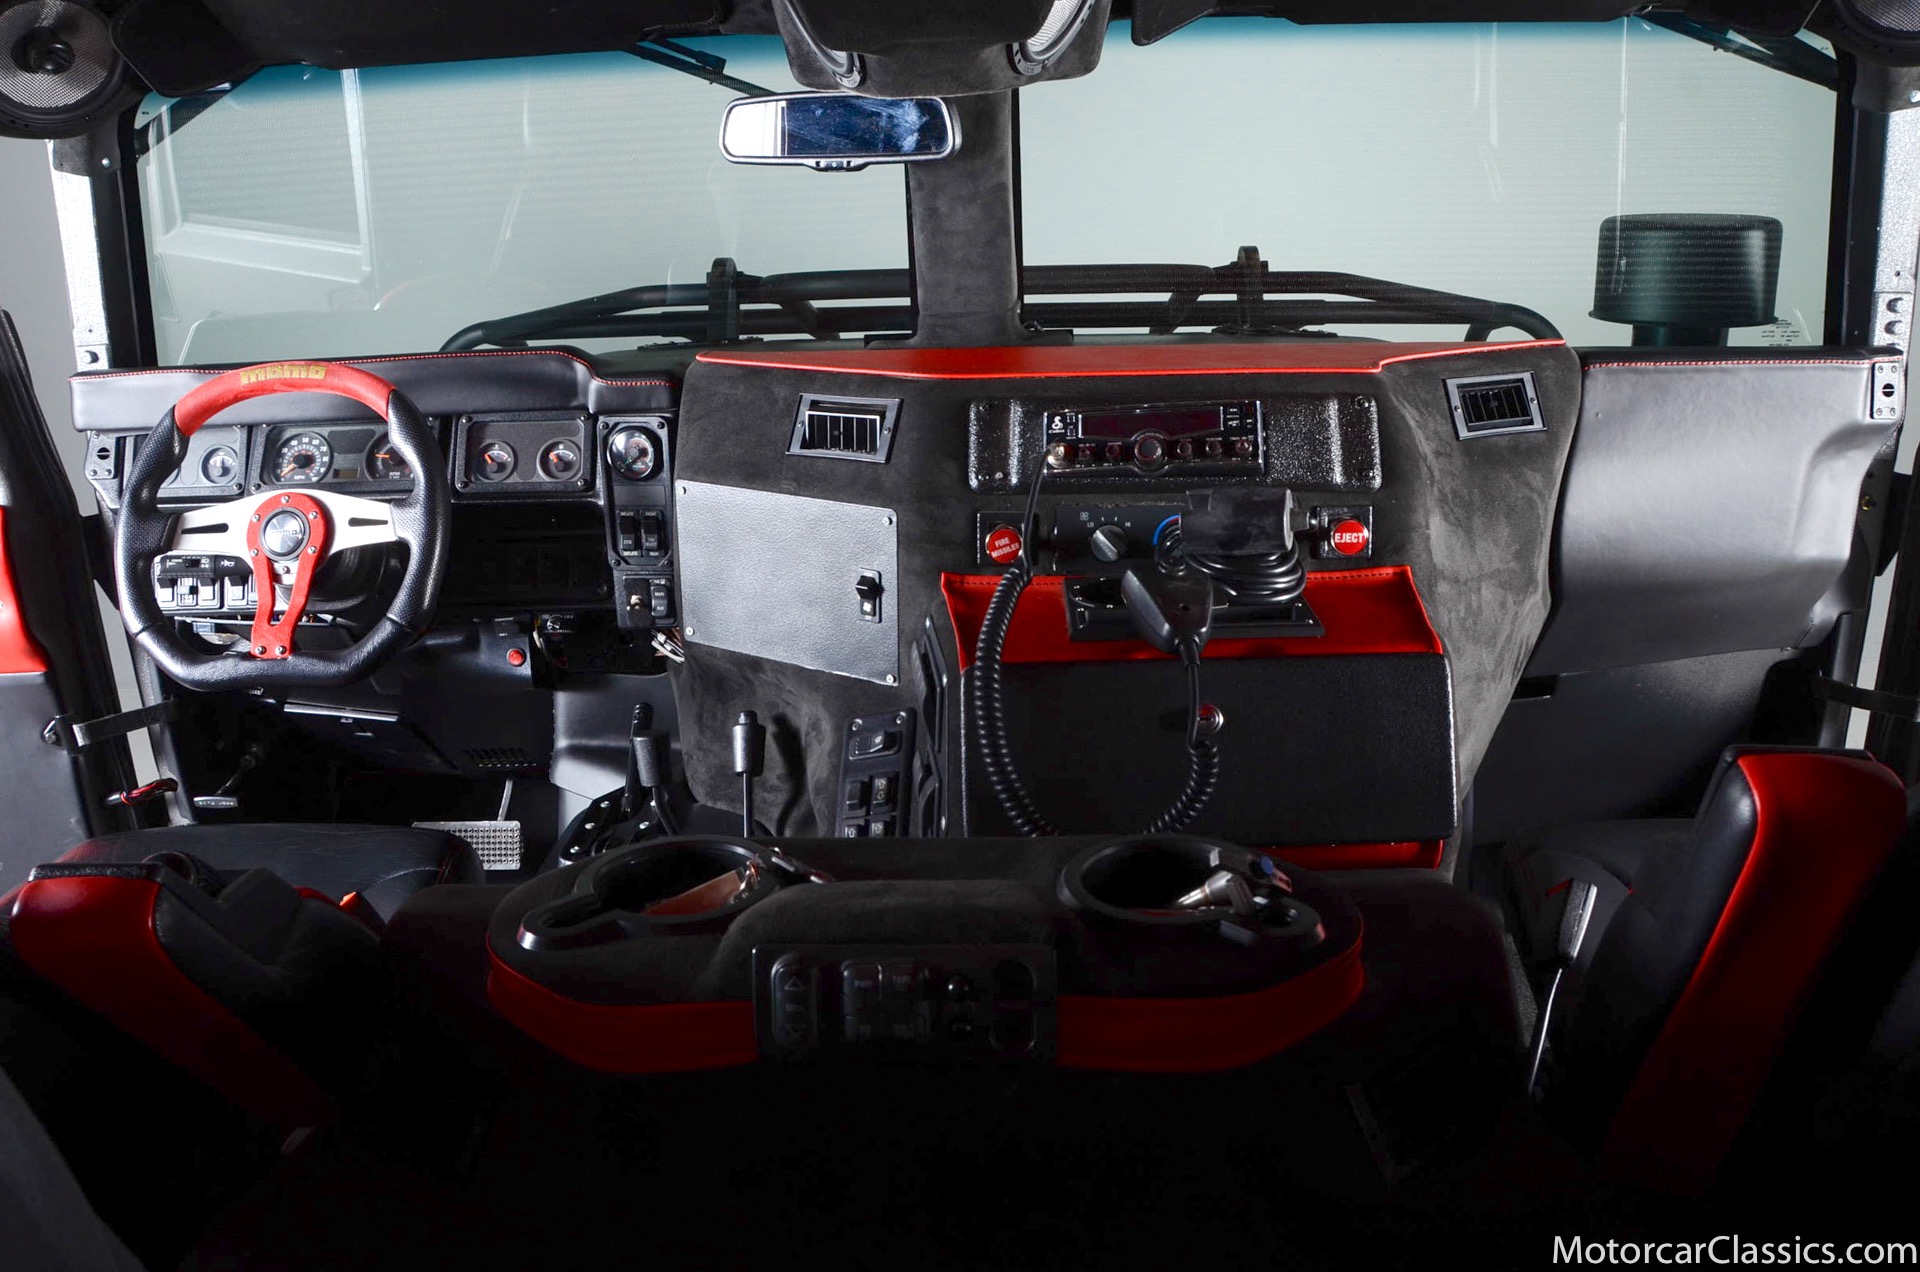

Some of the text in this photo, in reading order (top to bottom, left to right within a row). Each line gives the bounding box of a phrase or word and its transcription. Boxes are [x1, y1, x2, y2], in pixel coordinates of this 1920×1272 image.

[994, 536, 1010, 548] FIRE
[1334, 532, 1364, 543] EJECT
[991, 542, 1020, 559] MISSILES
